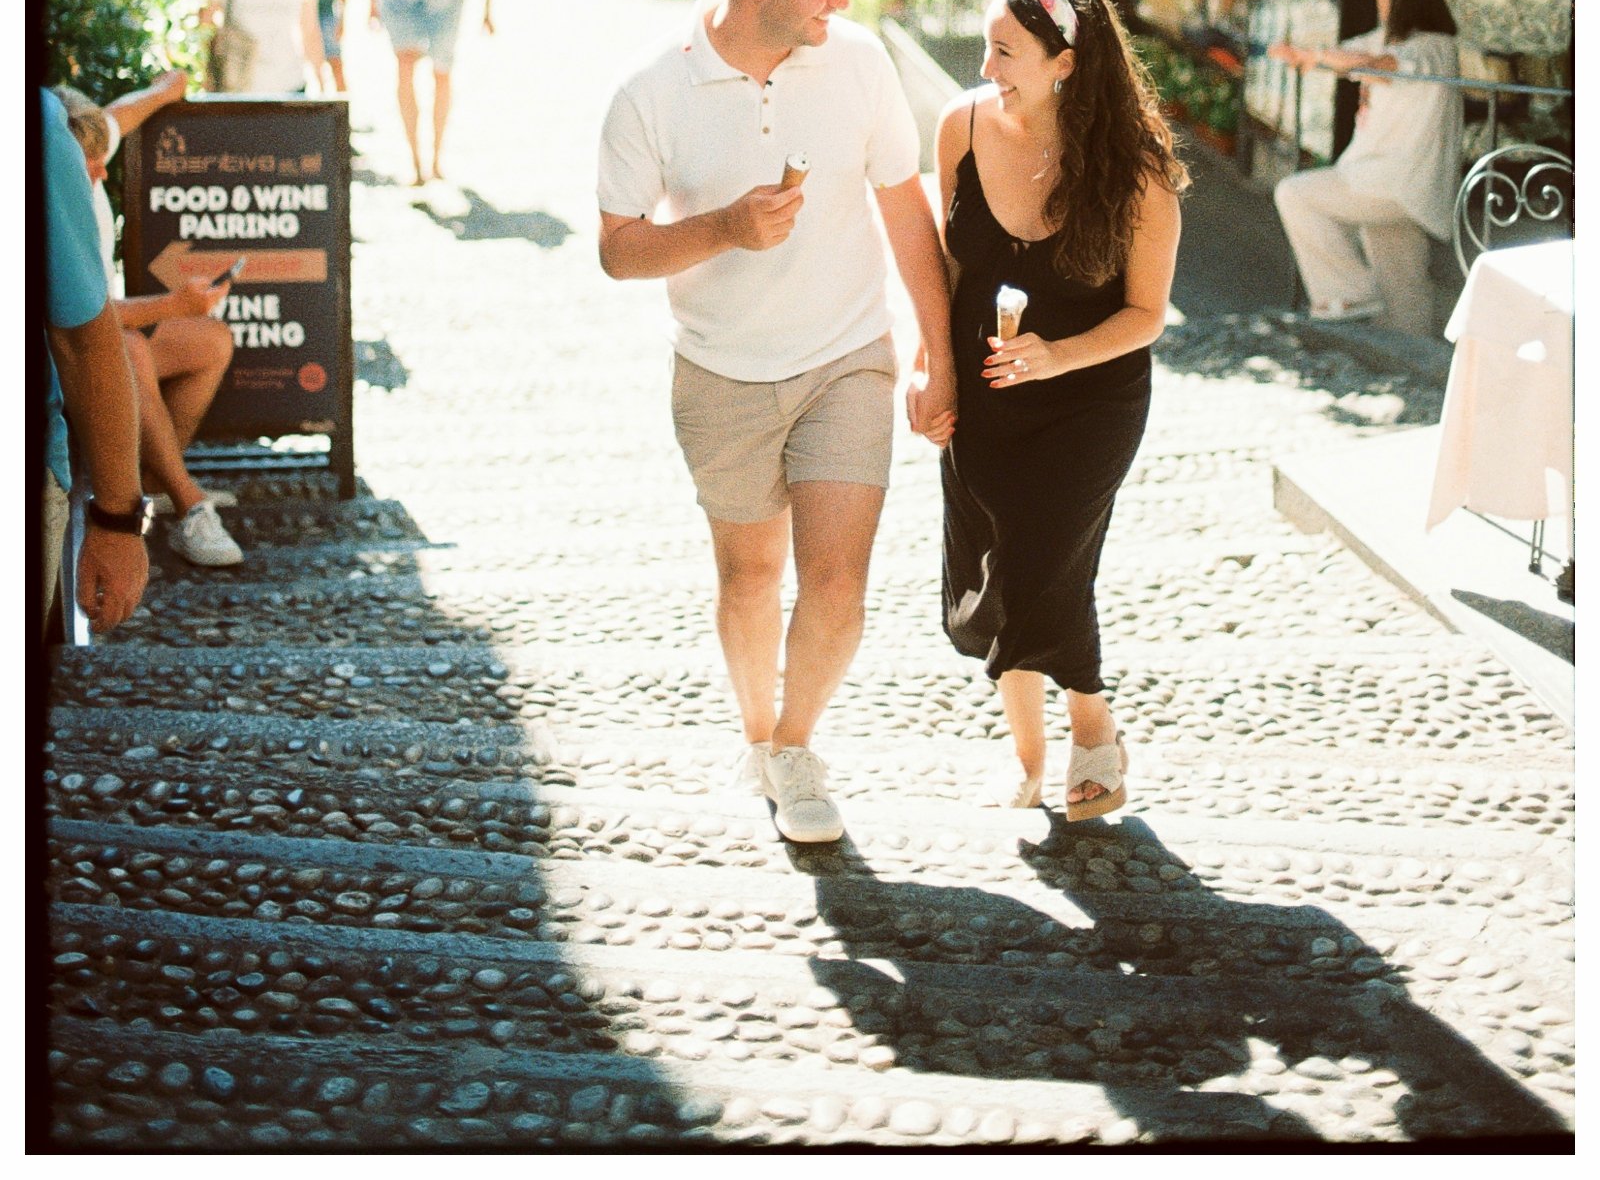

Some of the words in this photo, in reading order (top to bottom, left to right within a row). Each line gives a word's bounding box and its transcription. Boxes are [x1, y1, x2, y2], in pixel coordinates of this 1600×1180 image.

[150, 185, 228, 213] FOOD
[252, 184, 329, 211] WINE
[179, 212, 300, 240] PAIRING
[230, 321, 306, 348] TING
